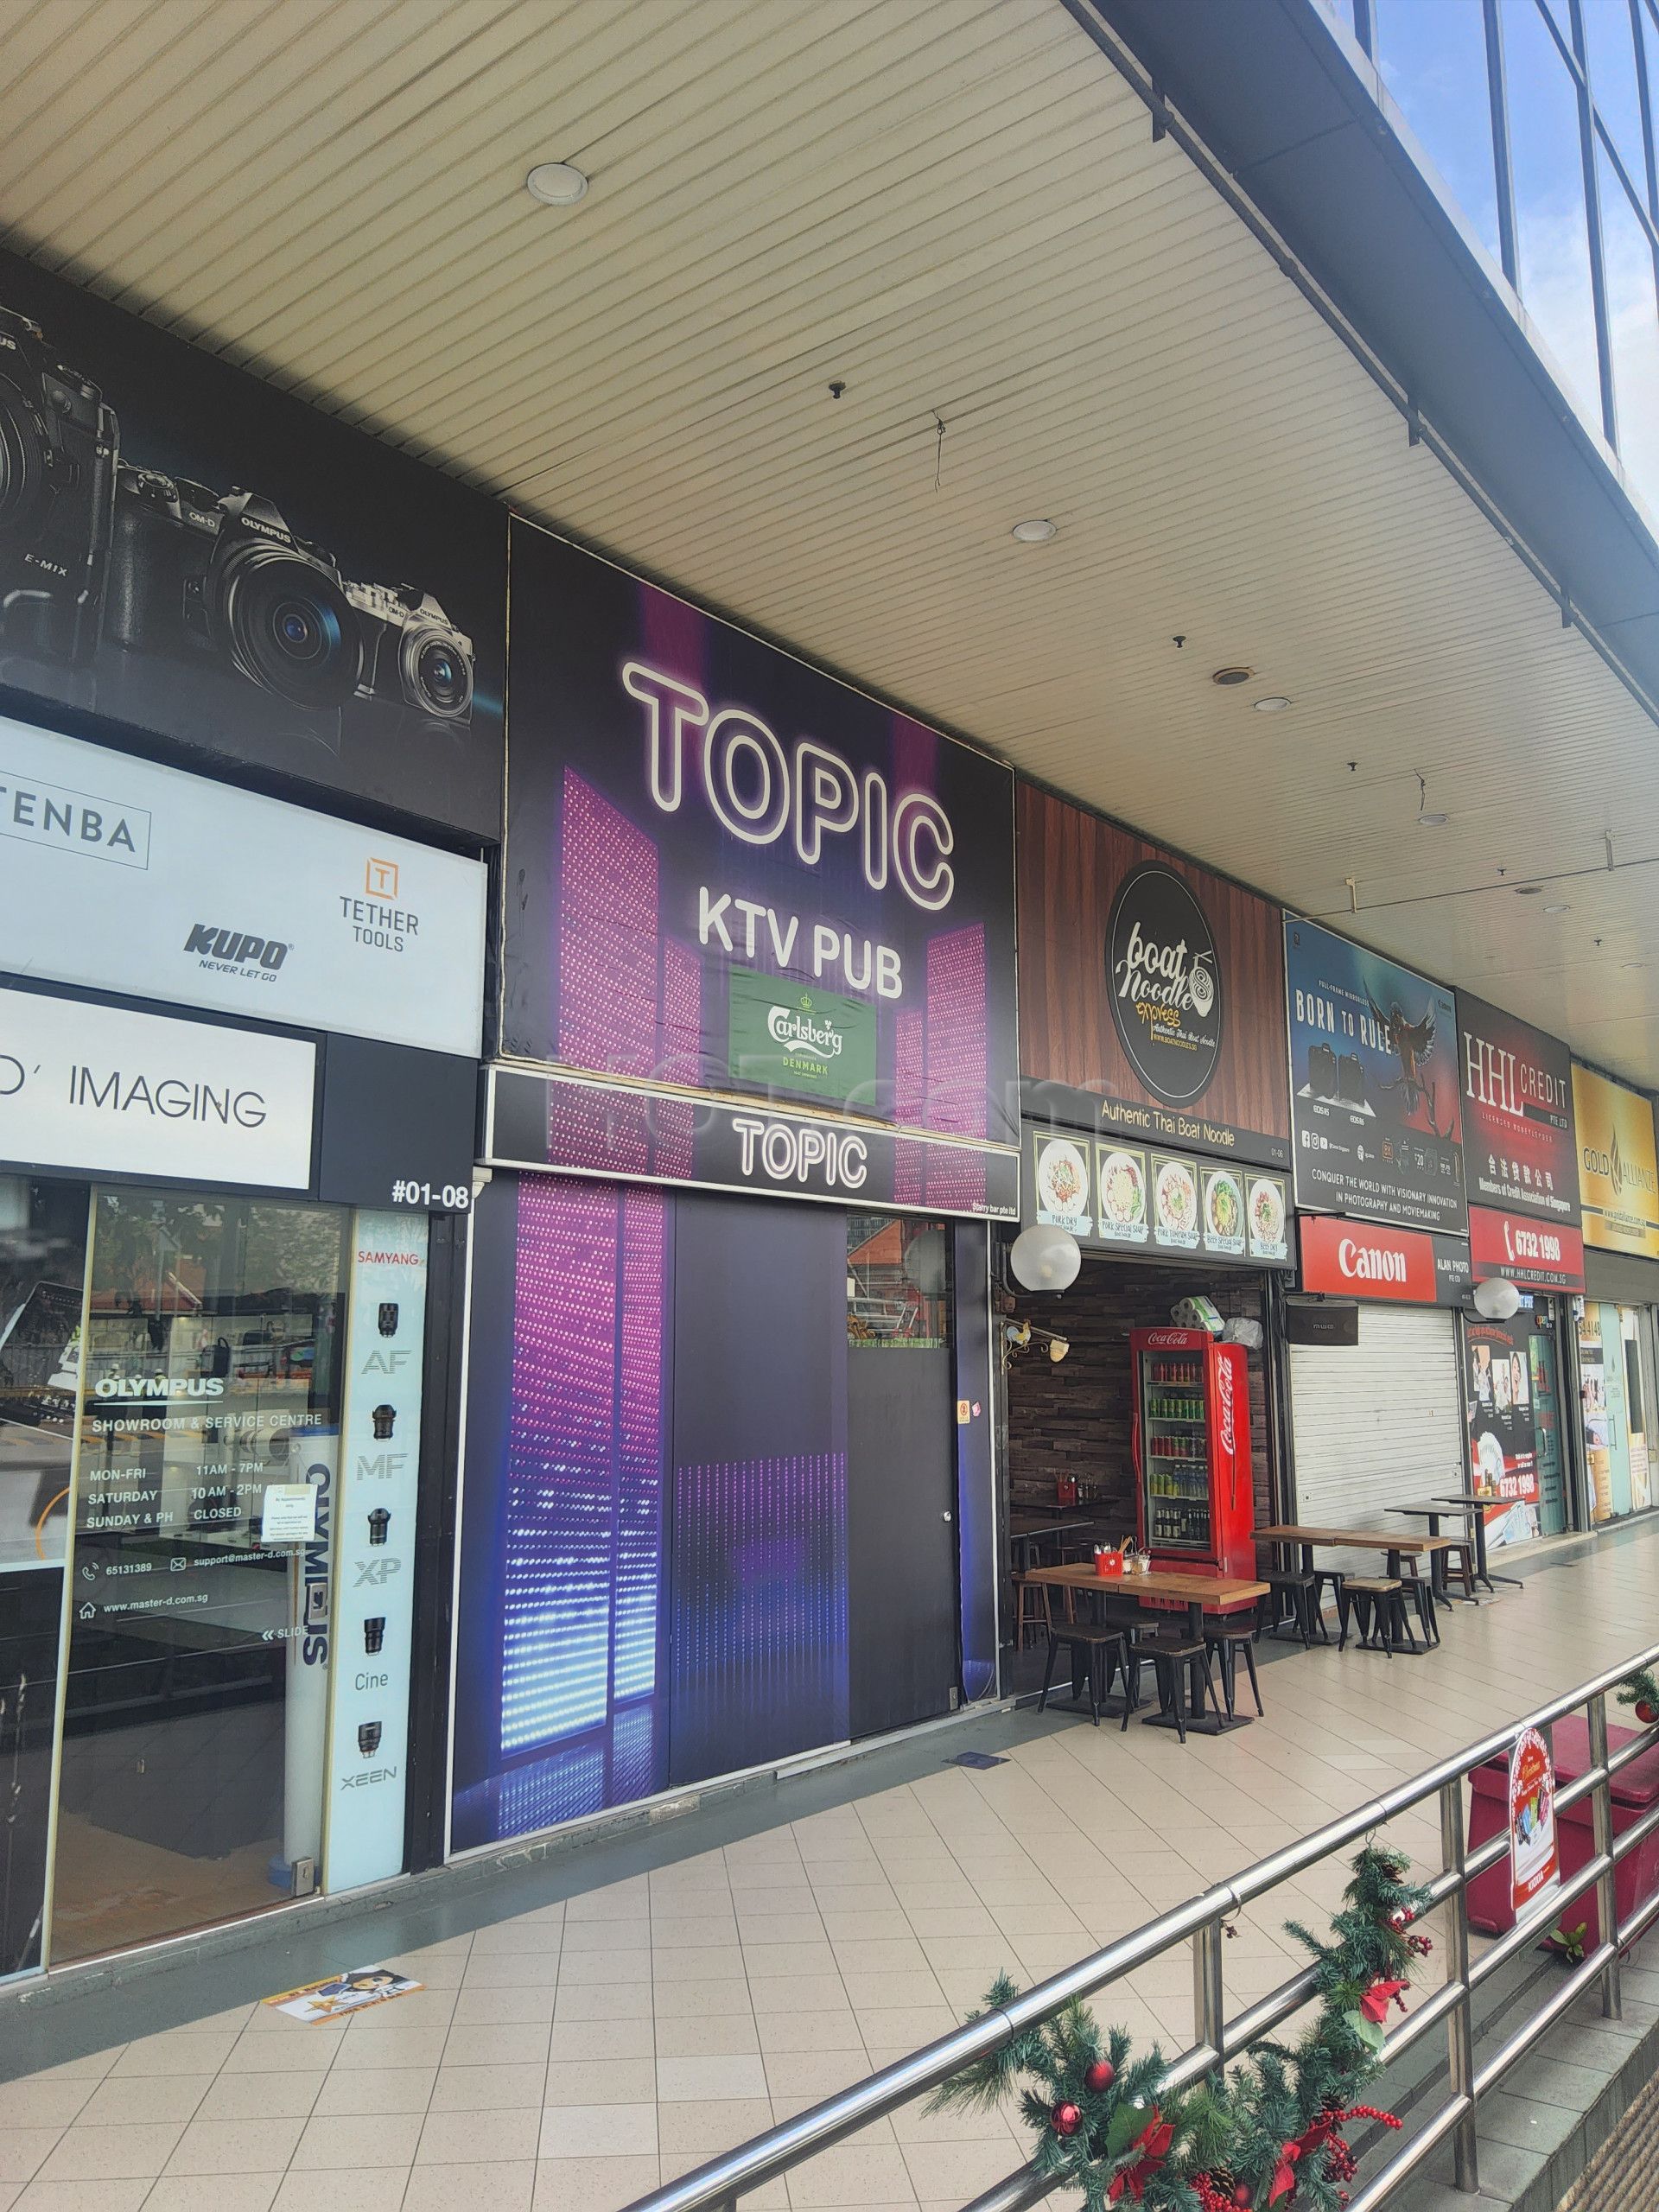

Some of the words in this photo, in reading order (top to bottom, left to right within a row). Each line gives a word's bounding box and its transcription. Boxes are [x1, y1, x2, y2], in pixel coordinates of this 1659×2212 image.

[241, 517, 292, 543] OLYMPUS
[420, 608, 448, 625] OLYMPUS
[621, 661, 955, 911] TOPIC
[339, 895, 420, 937] TETHER
[353, 925, 405, 953] TOOLS
[698, 886, 799, 967] KTV
[813, 924, 904, 1000] PUB
[199, 958, 238, 976] NEVER
[239, 967, 262, 981] LET
[261, 971, 277, 983] GO
[767, 1005, 843, 1058] Carlsberg
[1295, 988, 1335, 1034] BORN
[1341, 1010, 1354, 1037] TO
[1359, 1014, 1392, 1055] RULE
[783, 1056, 830, 1075] DENMARK
[1463, 1031, 1523, 1117] HHL
[1521, 1063, 1566, 1109] CREDIT
[68, 1064, 268, 1128] IMAGING
[1101, 1099, 1151, 1128] Authentic
[1153, 1110, 1176, 1134] Thai
[1178, 1116, 1201, 1141] Boat
[1203, 1122, 1235, 1147] Noodle
[1559, 1116, 1567, 1128] LTD
[732, 1118, 868, 1190] TOPIC
[1583, 1147, 1610, 1176] GOLD
[391, 1179, 471, 1210] #01-08
[1312, 1168, 1344, 1185] CONQUER
[1344, 1175, 1357, 1189] THE
[1357, 1177, 1380, 1193] WORLD
[1381, 1183, 1396, 1198] WITH
[1396, 1186, 1427, 1202] VISIONARY
[1427, 1193, 1458, 1209] INNOVATION
[1478, 1176, 1501, 1193] Members
[1506, 1184, 1521, 1199] Credit
[1336, 1191, 1343, 1202] IN
[1344, 1192, 1389, 1211] PHOTOGRAPHY
[1389, 1200, 1401, 1214] AND
[1402, 1205, 1440, 1222] MOVIEMAKING
[357, 1250, 418, 1266] SAMYANG
[1338, 1238, 1407, 1282] Canon
[1515, 1230, 1538, 1258] 6732
[1539, 1234, 1560, 1262] 1998
[1437, 1258, 1452, 1271] ALAN
[1452, 1260, 1469, 1273] PHOTO
[361, 1350, 413, 1375] AF
[94, 1377, 225, 1398] OLYMPUS
[92, 1418, 185, 1433] SHOWROOM
[191, 1417, 200, 1430] &
[205, 1414, 264, 1429] SERVICE
[269, 1413, 322, 1427] CENTRE
[90, 1468, 147, 1482] MON-FRI
[197, 1465, 227, 1477] 11AM
[239, 1462, 264, 1474] 7PM
[355, 1452, 409, 1481] MF
[87, 1489, 158, 1504] SATURDAY
[191, 1487, 207, 1500] 10
[207, 1484, 226, 1497] AM
[236, 1483, 263, 1496] 2PM
[86, 1513, 141, 1529] SUNDAY
[143, 1511, 152, 1524] &
[156, 1510, 174, 1523] PH
[194, 1506, 242, 1521] CLOSED
[105, 1562, 152, 1576] 65131389
[194, 1548, 307, 1567] support@master-d.com.sg
[352, 1556, 401, 1588] XP
[104, 1592, 208, 1614] www.master-d.com.sg
[276, 1624, 309, 1639] SLIDE
[354, 1671, 389, 1691] Cine
[340, 1765, 397, 1791] XEEN
